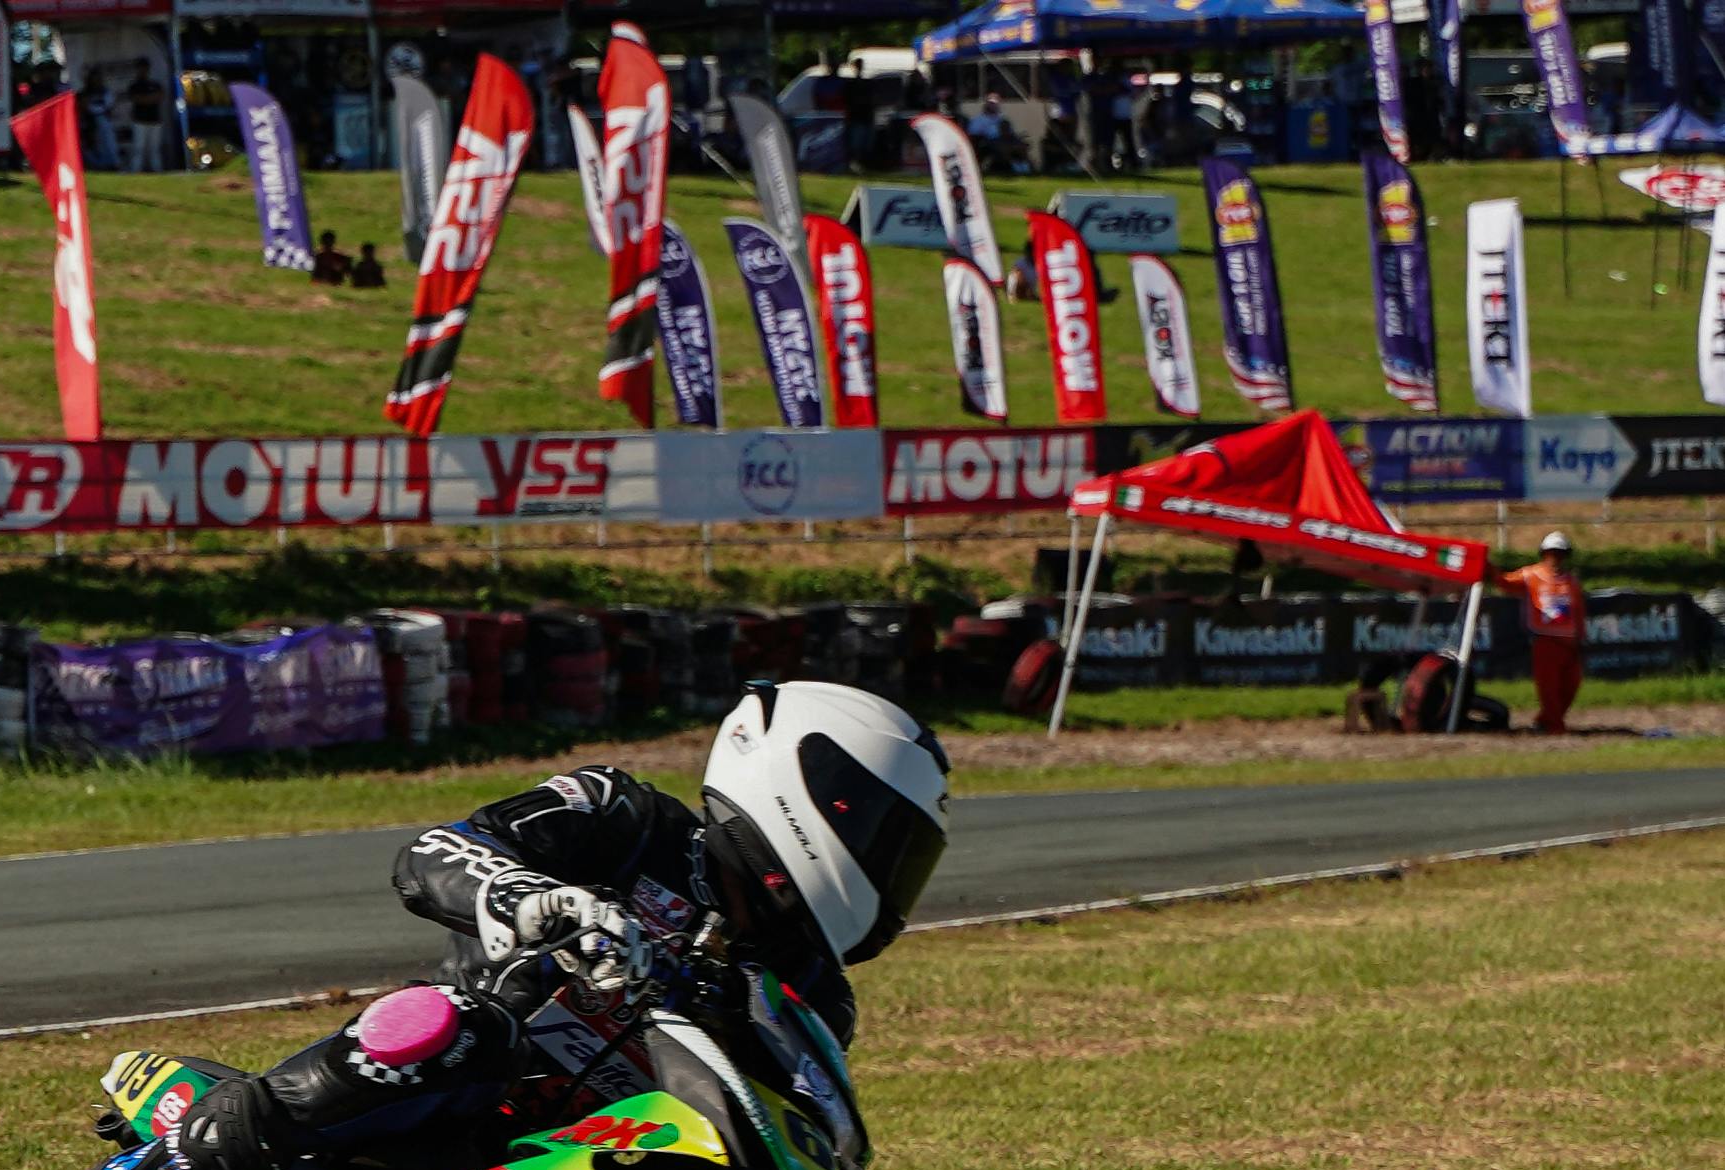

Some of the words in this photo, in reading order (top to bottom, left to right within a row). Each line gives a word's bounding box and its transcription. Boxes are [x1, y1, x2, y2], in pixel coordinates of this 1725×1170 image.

[1076, 194, 1175, 238] Faito
[821, 242, 875, 398] MOTUL
[1044, 240, 1099, 393] MOTUL
[888, 435, 1093, 503] MOTUL
[1387, 426, 1502, 451] ACTION
[1539, 436, 1616, 483] Koyo
[116, 437, 431, 528] MOTUL
[477, 439, 617, 515] YSS
[1193, 616, 1326, 657] Kawasaki
